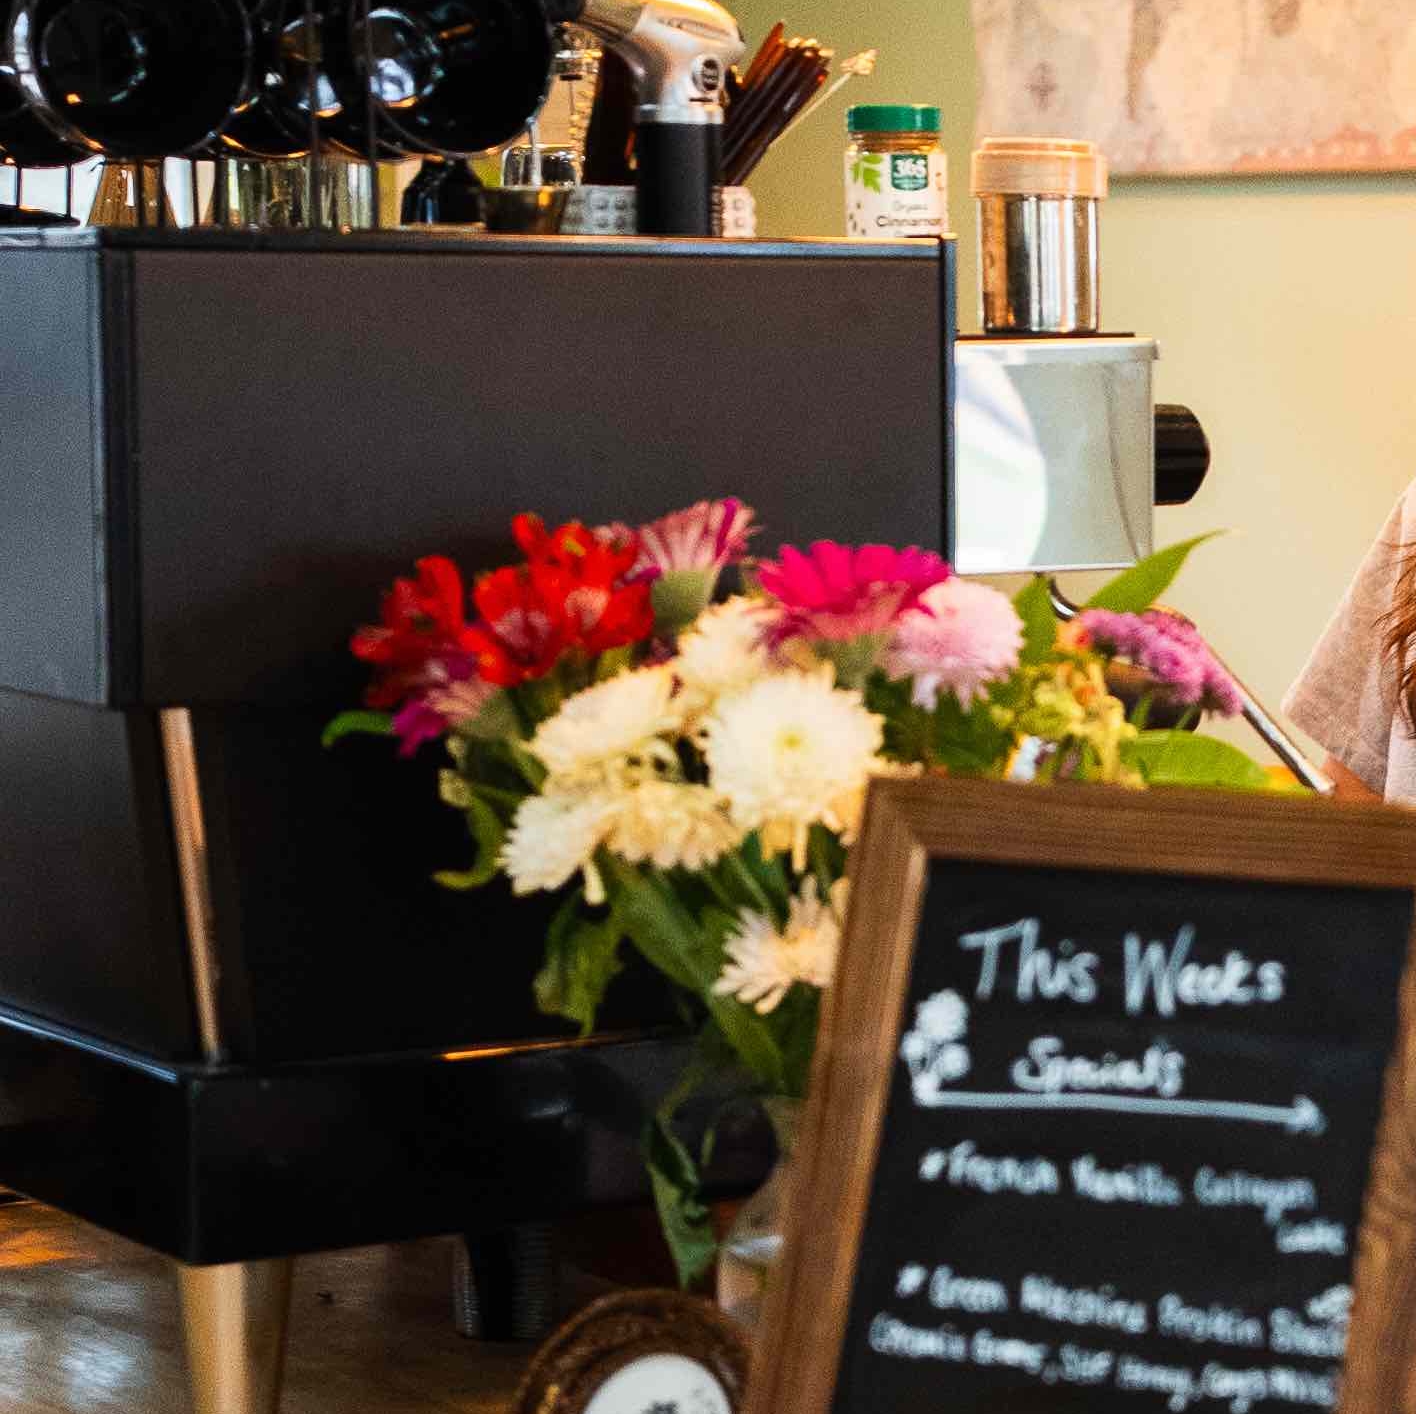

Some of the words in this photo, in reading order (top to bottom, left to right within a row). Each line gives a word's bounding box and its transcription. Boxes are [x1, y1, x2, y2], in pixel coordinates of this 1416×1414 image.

[894, 158, 927, 178] 365
[959, 917, 1098, 1003] This
[1124, 924, 1285, 1016] Weeks
